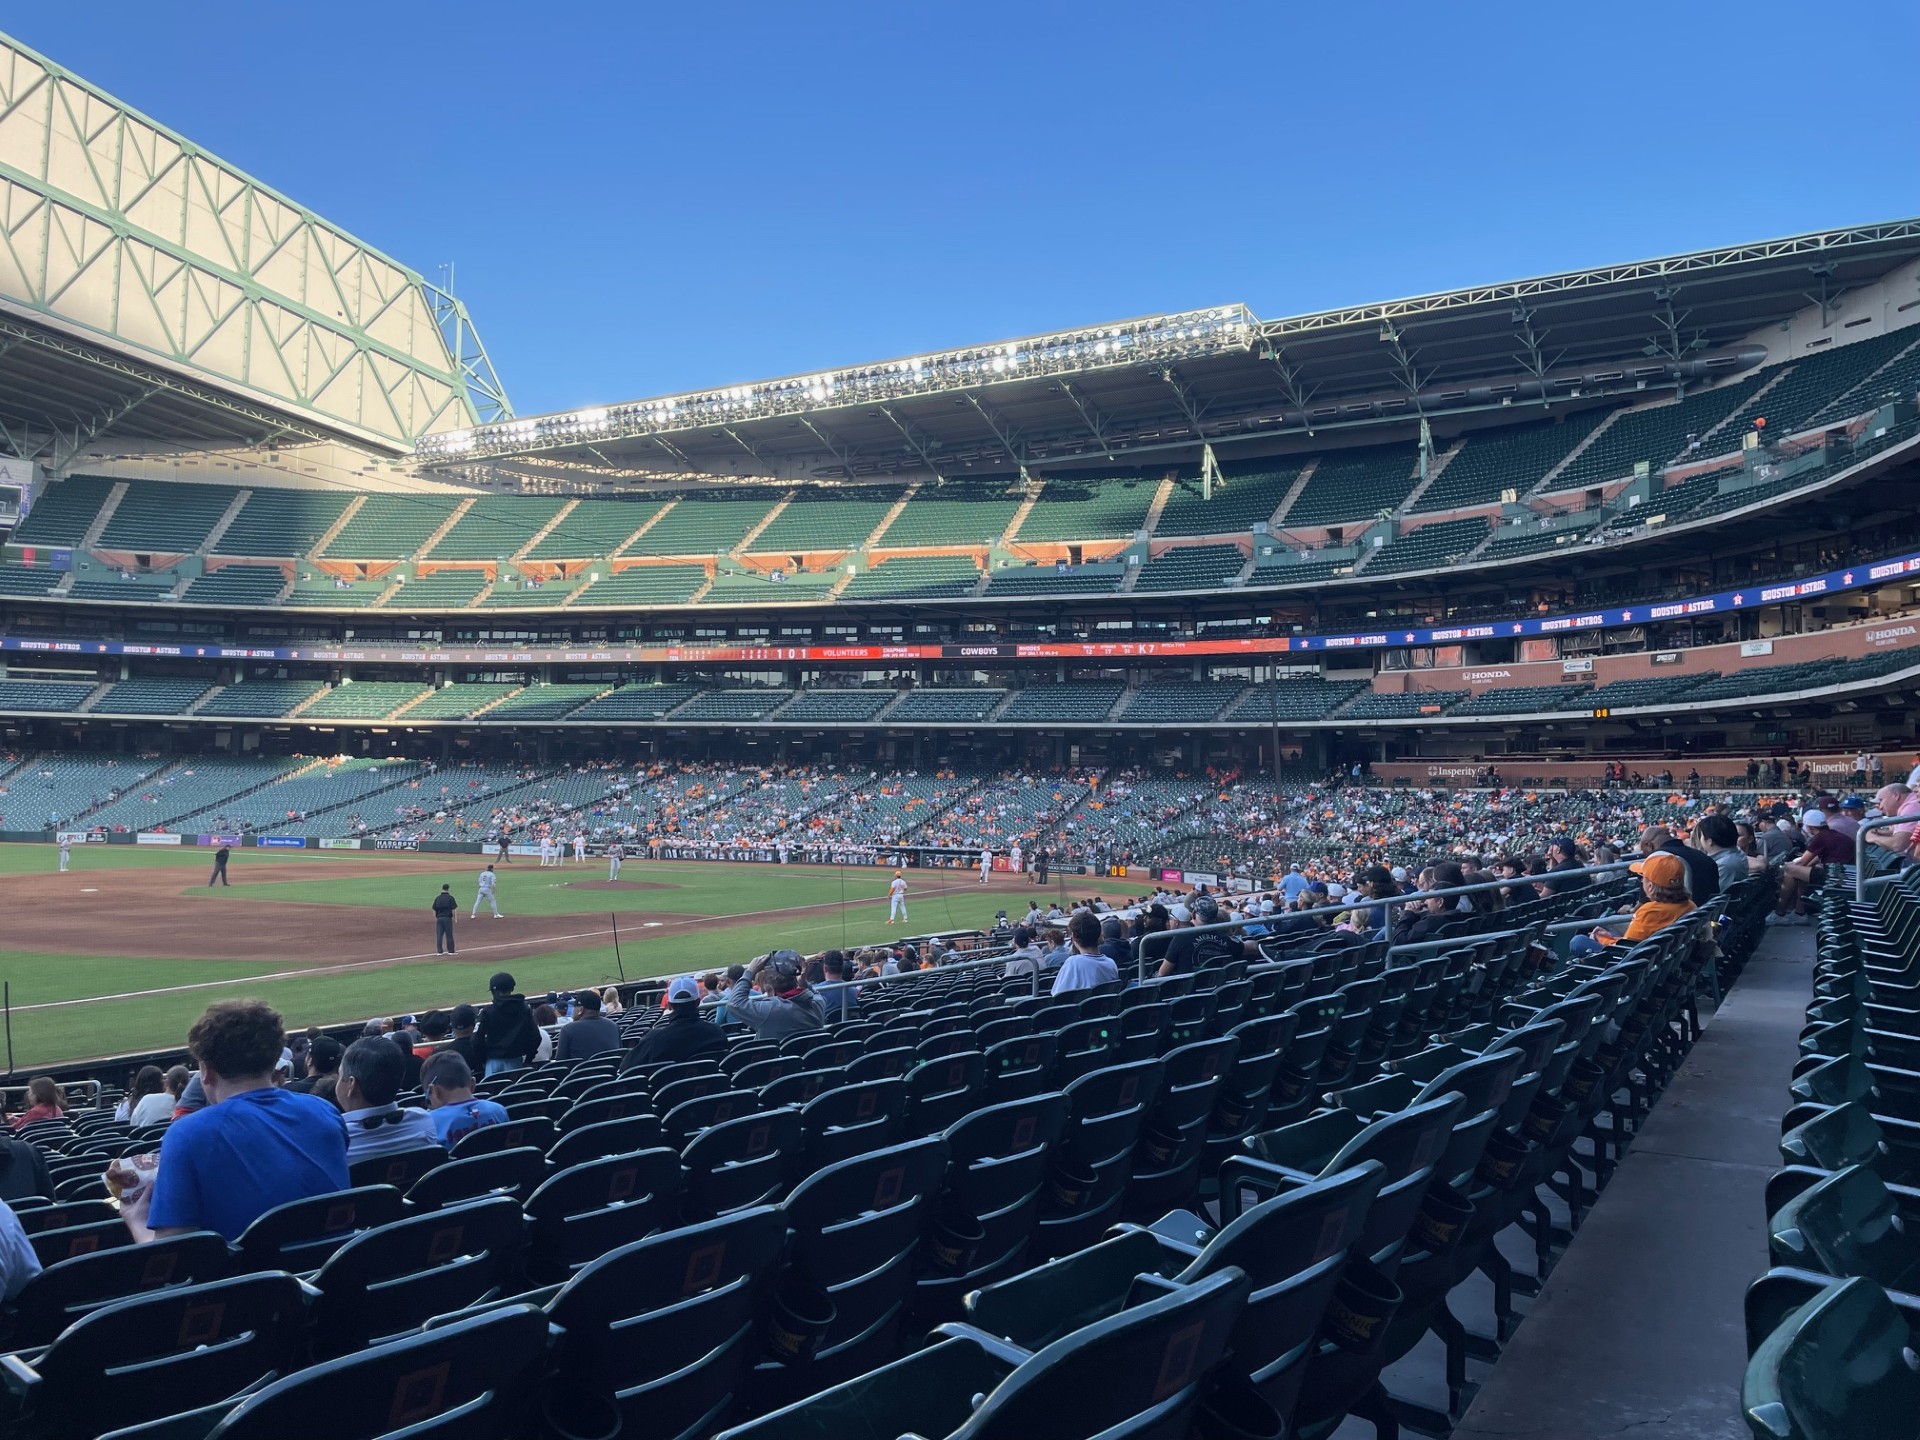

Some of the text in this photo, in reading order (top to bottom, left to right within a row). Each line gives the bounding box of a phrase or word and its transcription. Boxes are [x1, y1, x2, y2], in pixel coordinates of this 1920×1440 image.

[1870, 562, 1904, 579] HOUSTON
[1761, 580, 1826, 601] HOUSTON ASTROS
[1651, 600, 1715, 618] HOUSTON ASTROS
[1541, 615, 1603, 630] HOUSTON ASTROS
[1432, 627, 1494, 640] HOUSTON ASTROS
[1876, 625, 1917, 640] HONDA
[20, 641, 49, 649] HOUSTON
[1326, 635, 1387, 647] HOUSTON ASTROS
[123, 645, 151, 653] HOUSTON
[961, 647, 998, 655] COWBOYS
[1139, 644, 1154, 654] K 7
[1471, 670, 1511, 679] HONDA
[1439, 766, 1476, 777] Insperity
[1812, 761, 1850, 774] Insperity
[1192, 933, 1228, 947] AMERICAN
